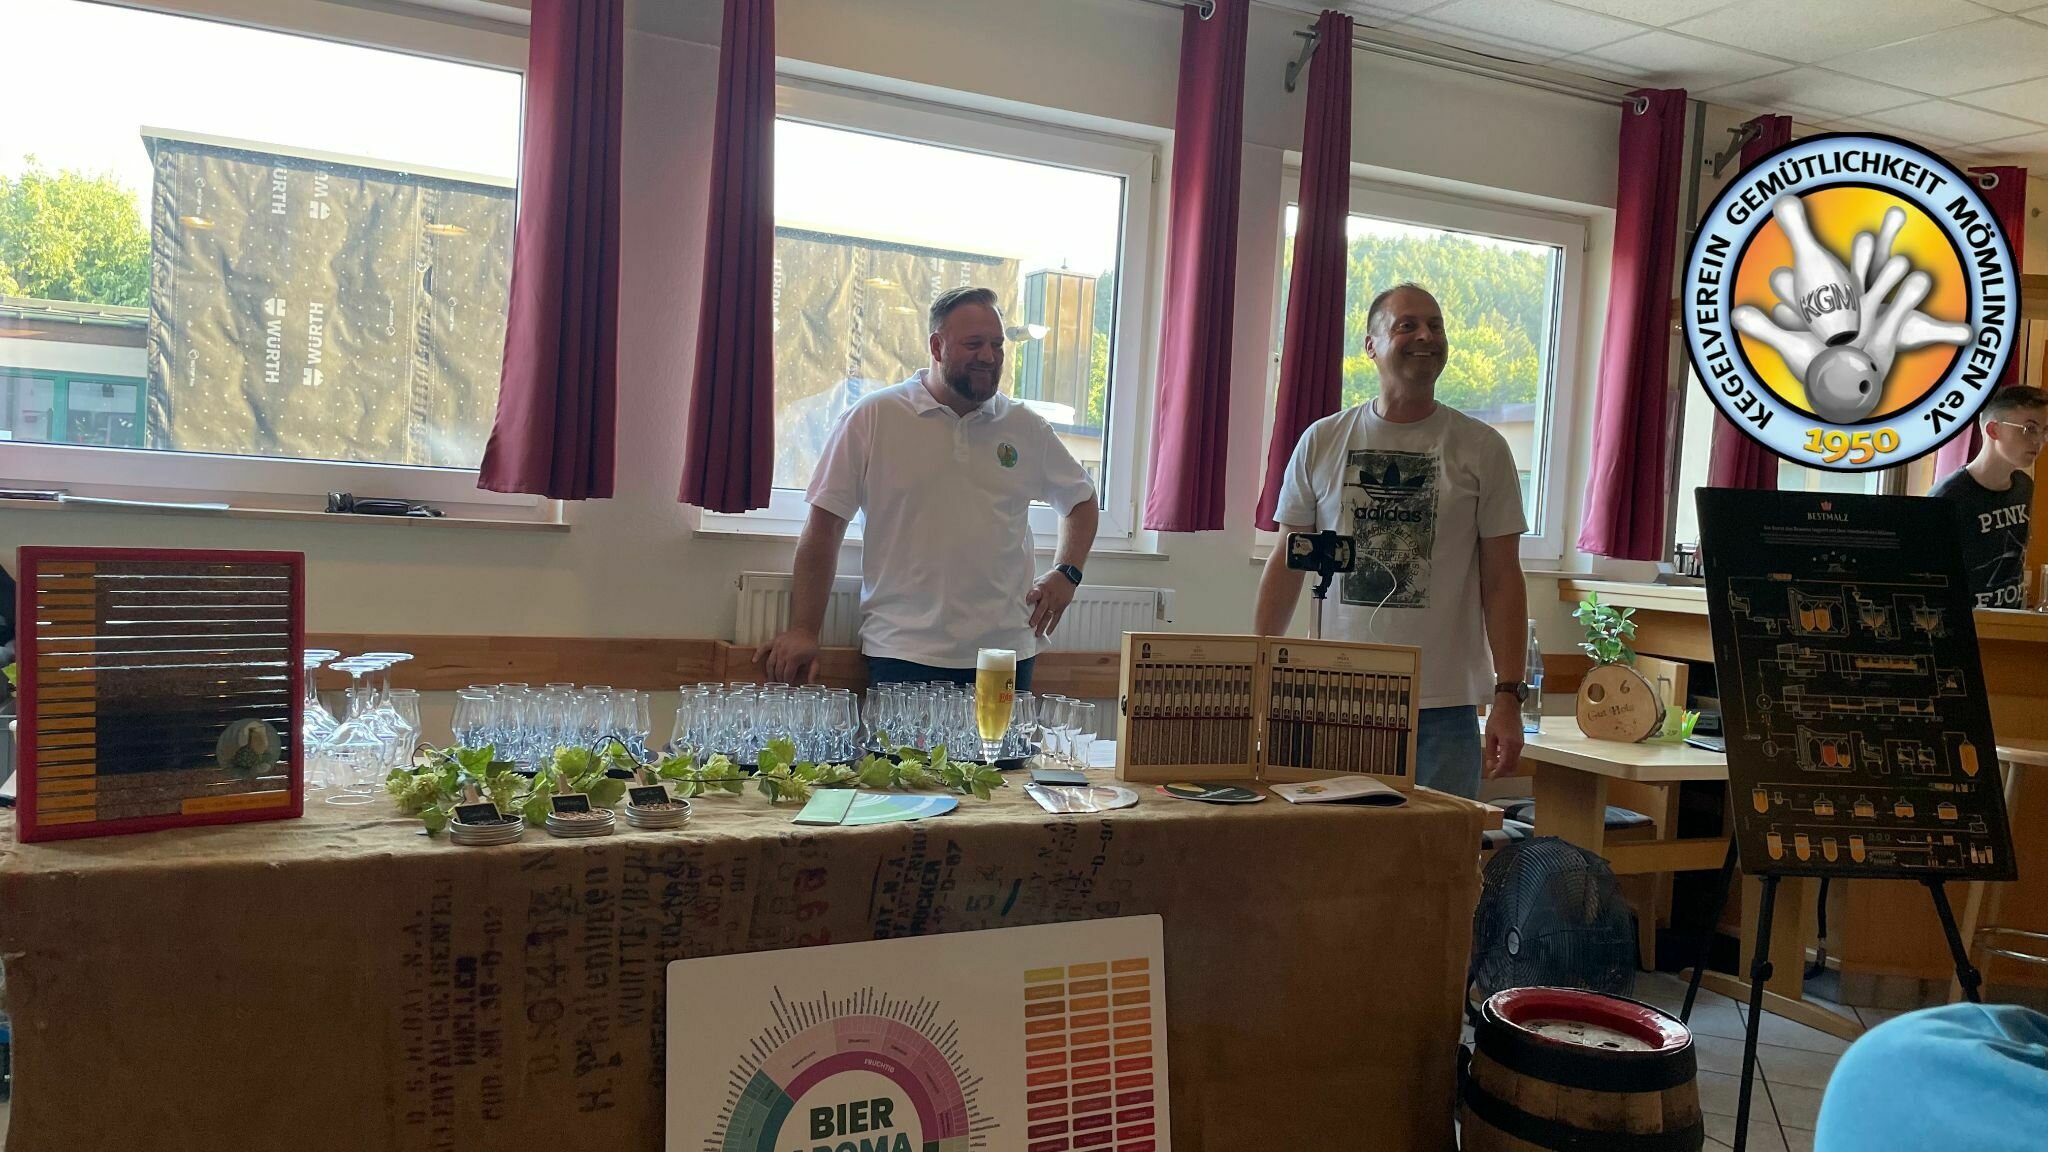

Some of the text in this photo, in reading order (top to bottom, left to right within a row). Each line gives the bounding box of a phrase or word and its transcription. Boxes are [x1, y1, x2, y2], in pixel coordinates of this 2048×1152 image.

[307, 302, 324, 365] WÜRTH
[265, 319, 281, 383] WÜRTH
[1354, 506, 1422, 523] adidas
[1807, 512, 1849, 522] BESTMALZ
[1977, 504, 2031, 534] PINK
[1619, 679, 1631, 694] 6
[810, 1097, 894, 1141] BIER
